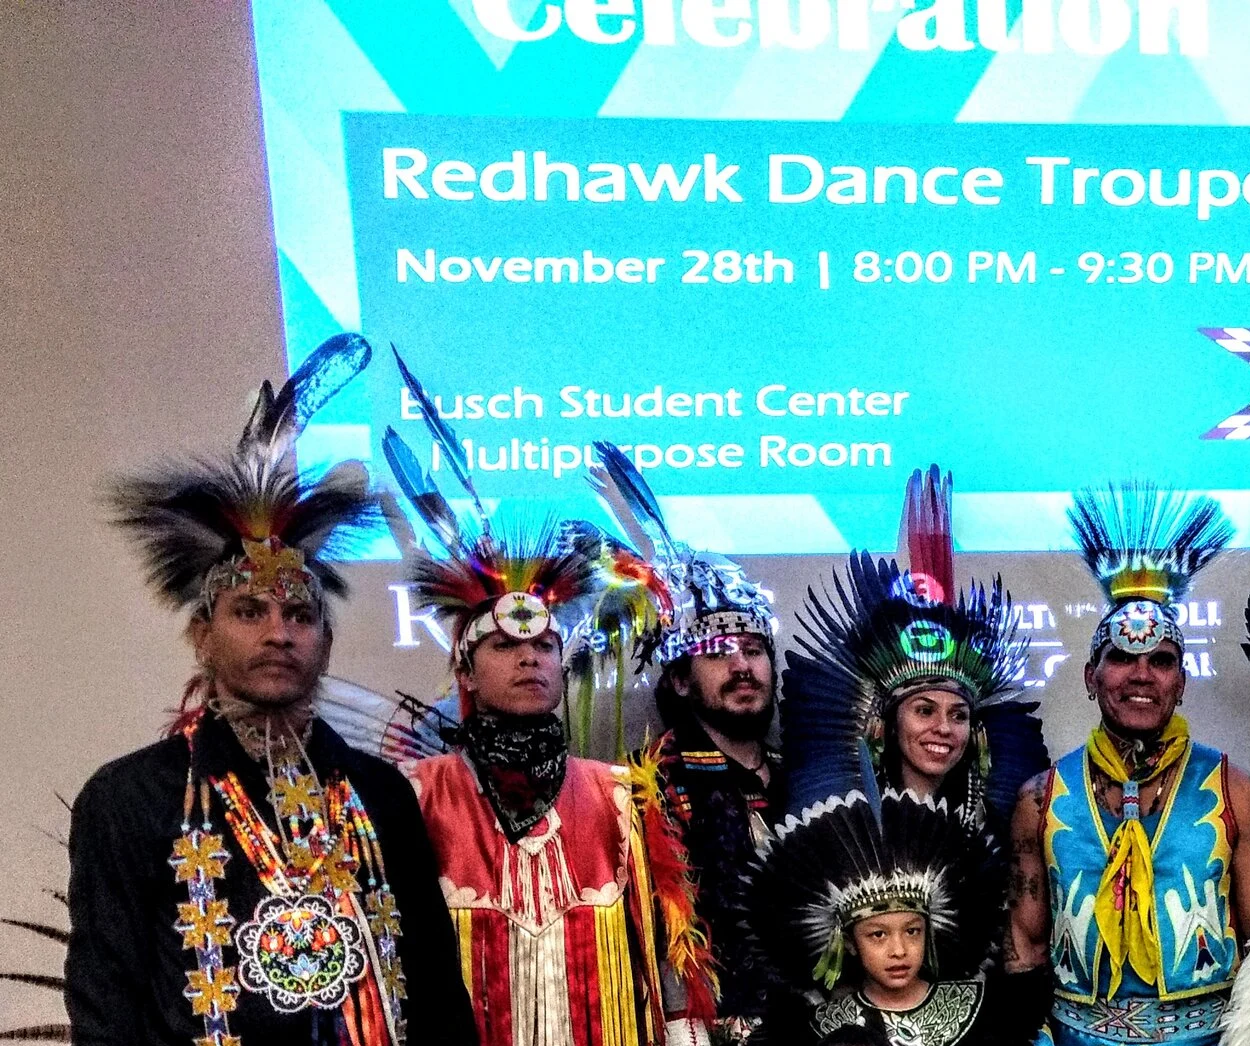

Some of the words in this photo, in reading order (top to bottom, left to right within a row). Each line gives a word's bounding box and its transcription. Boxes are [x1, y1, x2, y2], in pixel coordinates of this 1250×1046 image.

[382, 147, 744, 202] Redhawk
[768, 153, 1003, 206] Dance
[396, 248, 666, 284] November
[681, 249, 795, 284] 28th
[853, 251, 953, 284] 8:00
[967, 251, 1037, 284] PM
[1077, 251, 1174, 284] 9:30
[559, 385, 743, 418] Student
[756, 384, 909, 416] Center
[760, 435, 893, 468] Room
